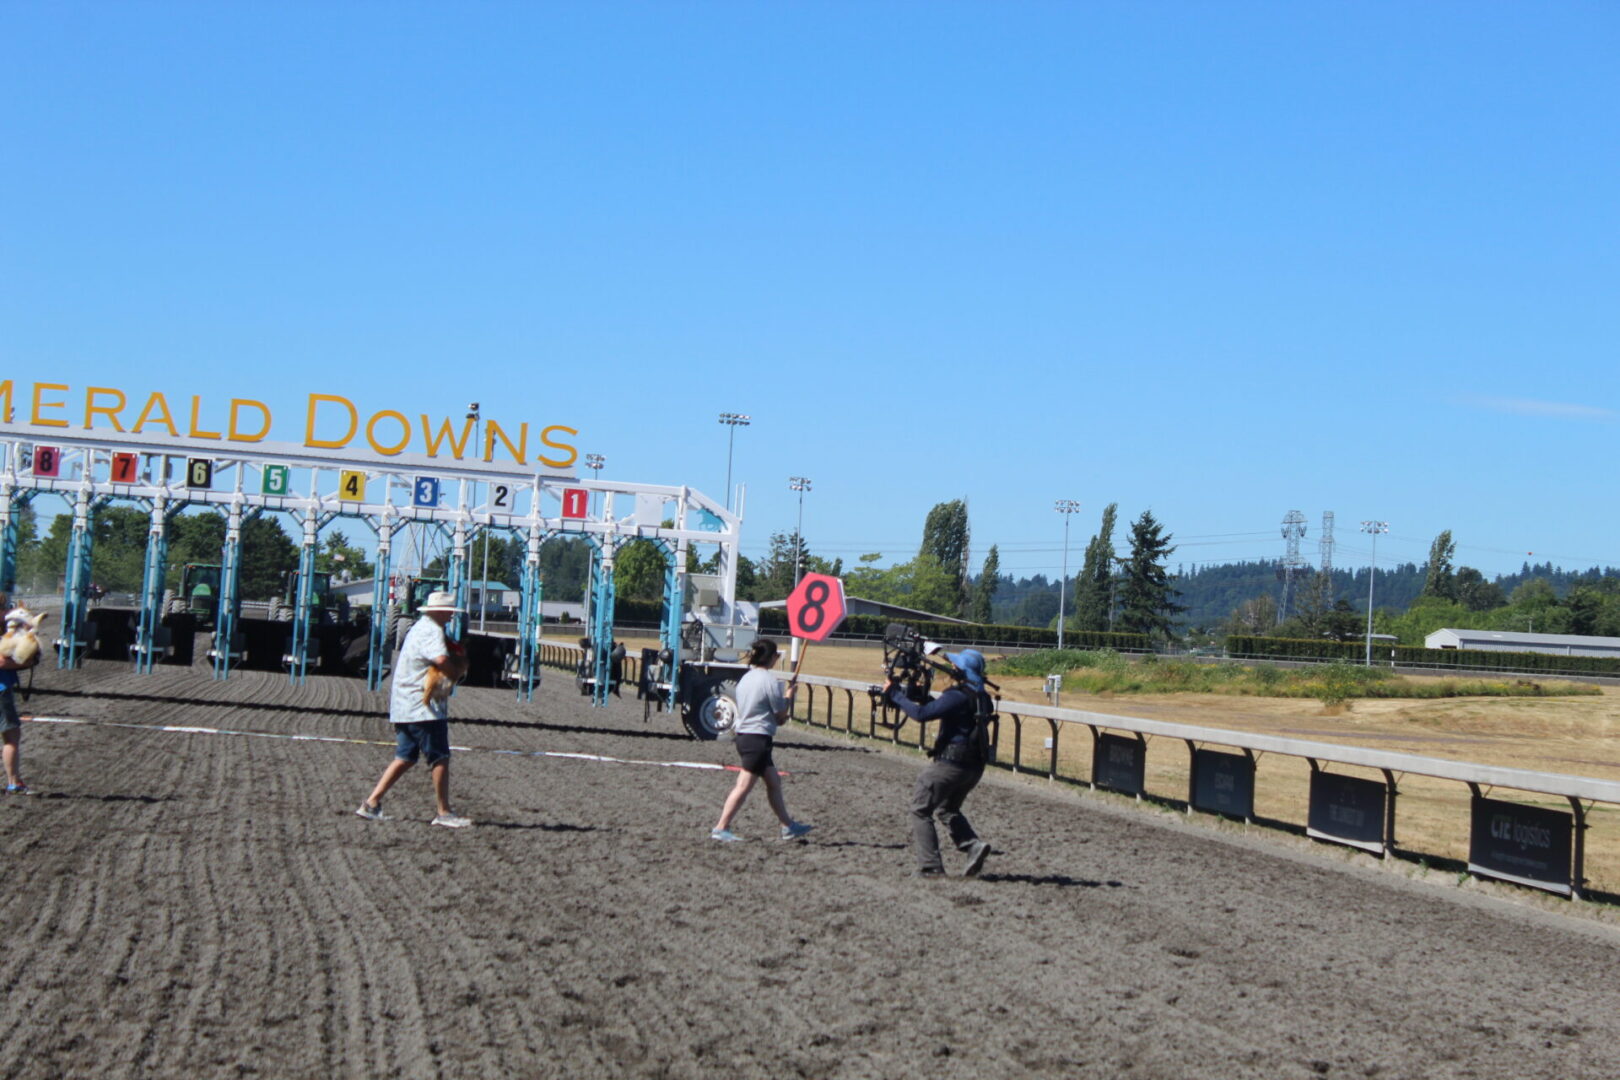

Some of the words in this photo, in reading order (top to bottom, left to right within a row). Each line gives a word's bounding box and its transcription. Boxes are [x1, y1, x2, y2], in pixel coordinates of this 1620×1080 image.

[304, 393, 578, 468] DOWNS
[40, 450, 52, 472] 8
[119, 458, 130, 479] 7
[193, 462, 206, 485] 6
[270, 469, 282, 491] 5
[345, 475, 358, 496] 4
[419, 481, 432, 503] 3
[495, 485, 508, 507] 2
[570, 493, 579, 514] 1
[798, 580, 830, 633] 8
